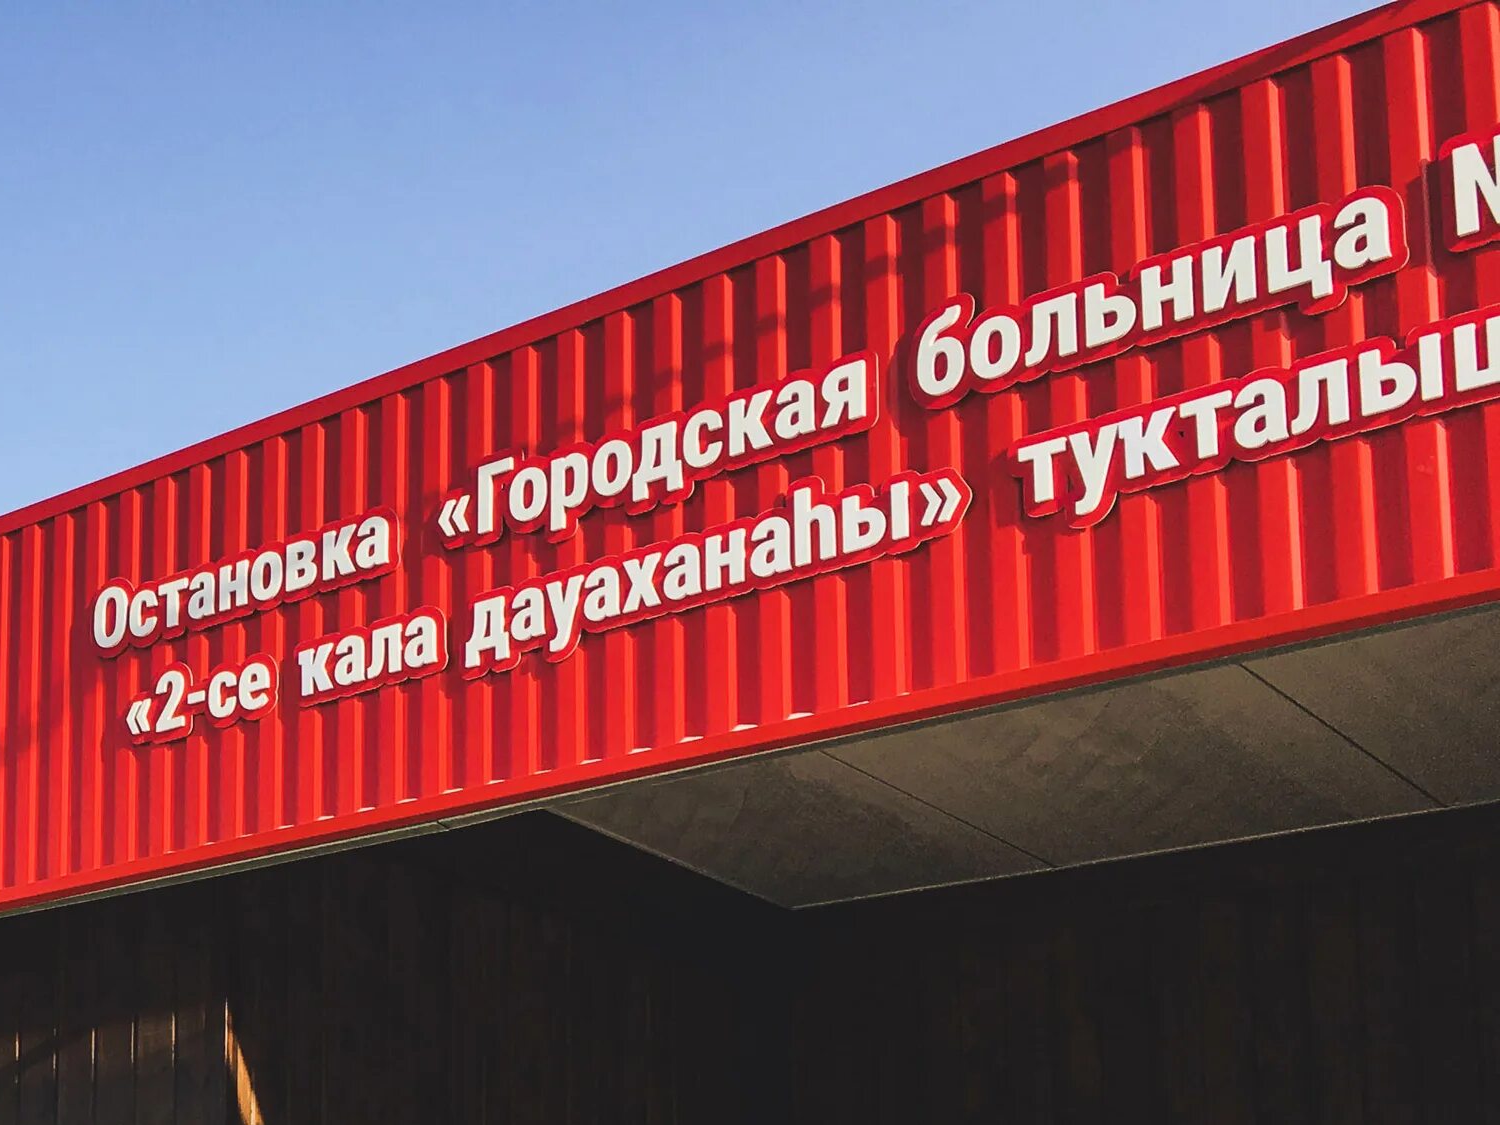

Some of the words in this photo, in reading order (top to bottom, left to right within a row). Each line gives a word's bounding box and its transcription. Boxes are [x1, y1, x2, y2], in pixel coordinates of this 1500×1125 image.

[93, 515, 391, 650] Остановка
[437, 358, 867, 538] «Городская
[915, 197, 1393, 398] больница
[126, 668, 272, 737] «2-се
[298, 614, 440, 698] кала
